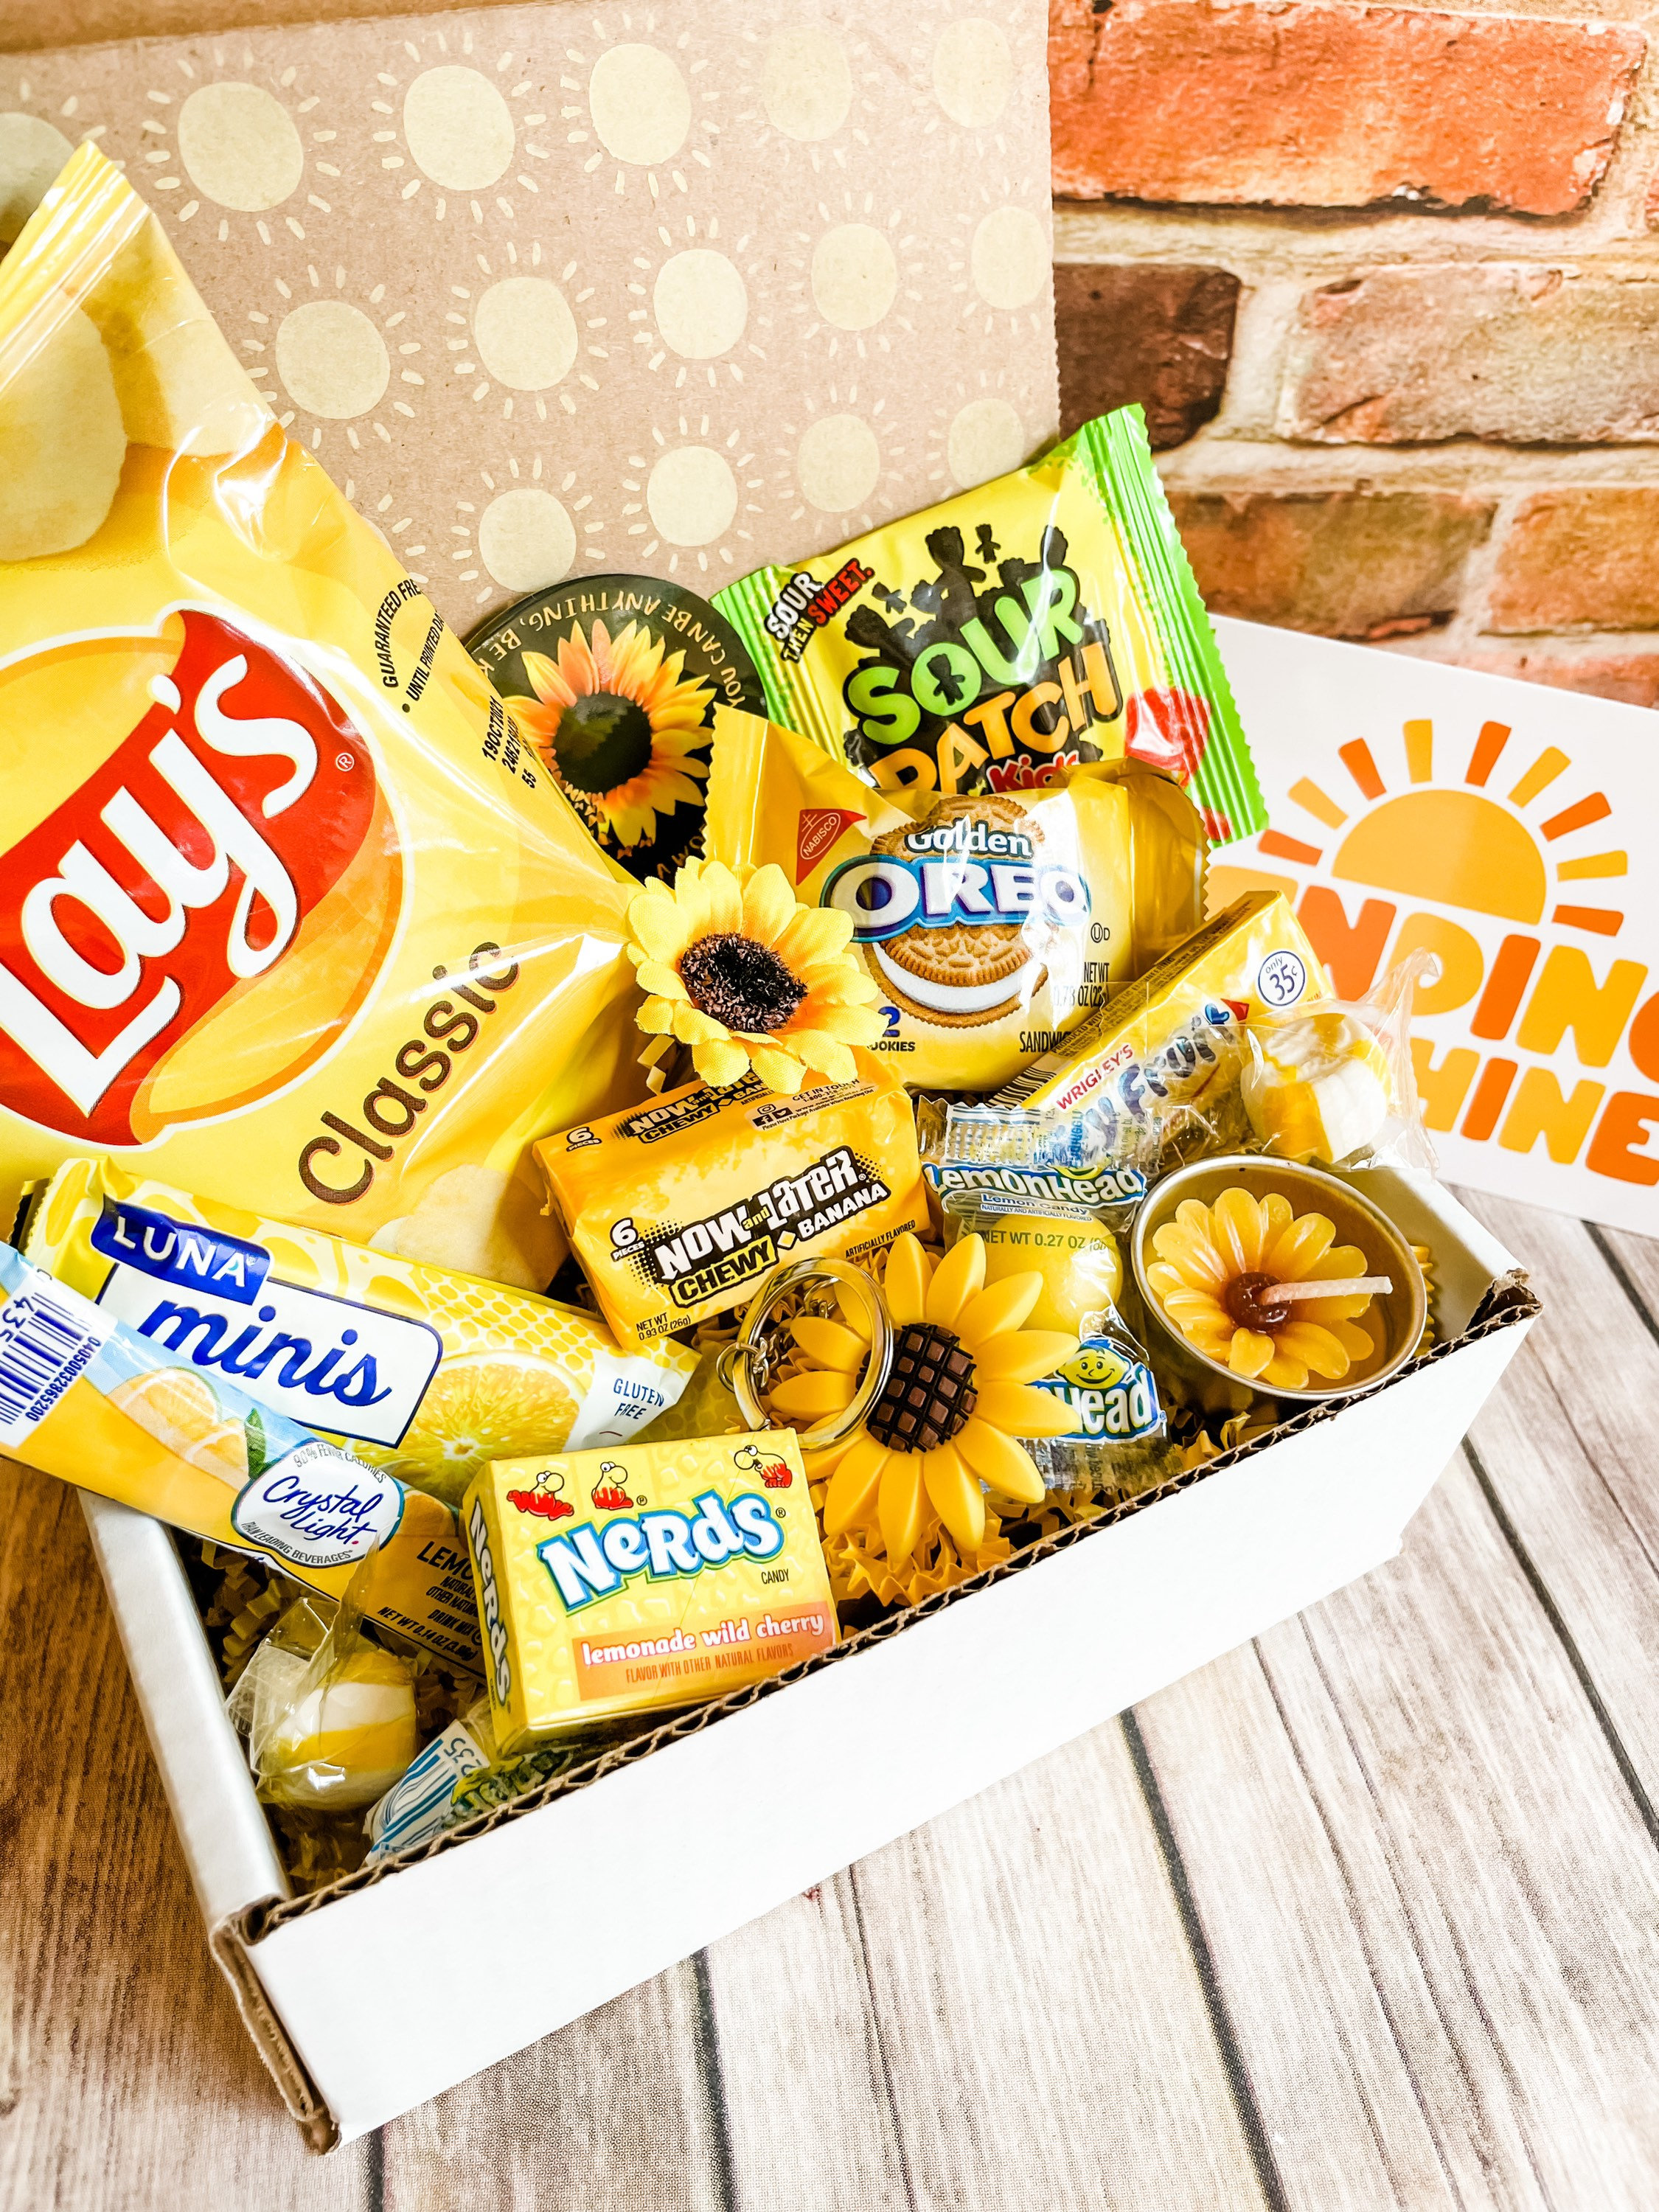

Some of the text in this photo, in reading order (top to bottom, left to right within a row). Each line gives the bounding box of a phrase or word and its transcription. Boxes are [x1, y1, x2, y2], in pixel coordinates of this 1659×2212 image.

[519, 591, 662, 633] ANYTHING,
[662, 603, 692, 625] BE
[766, 573, 824, 640] SOUR
[782, 560, 873, 661] THEN SWEET.
[375, 578, 422, 688] GUARANTEED FRE
[489, 627, 521, 662] BE
[686, 626, 727, 666] CAN
[406, 611, 445, 701] UNTIL PRINTED DA
[847, 569, 1083, 745] SOUR
[721, 667, 746, 708] YOU
[869, 640, 1118, 794] PATCH
[986, 750, 1079, 794] Kid
[802, 815, 838, 857] NABISCO
[906, 818, 1033, 855] Golden
[0, 653, 319, 1119] Lay's
[827, 857, 1088, 920] OREO
[1084, 962, 1109, 983] NET WT
[1209, 866, 1659, 1085] NDIN
[1265, 956, 1283, 974] only
[1077, 985, 1089, 1006] OZ
[878, 1006, 900, 1037] 2
[1051, 1023, 1088, 1054] PRODUCED
[866, 1031, 1073, 1053] OOKIES SANDWI
[298, 941, 521, 1206] Classic
[644, 1105, 716, 1141] CHEWY
[734, 1083, 769, 1099] BAN
[792, 1091, 810, 1102] GET
[812, 1087, 824, 1096] IN
[1409, 1038, 1659, 1187] HINE
[568, 1127, 593, 1141] 6
[628, 1096, 699, 1135] NOW
[981, 1204, 1014, 1214] NATURALLY
[982, 1193, 1037, 1208] Lemon
[112, 1216, 248, 1289] LUNA
[610, 1218, 639, 1249] 6
[653, 1203, 750, 1280] NOW
[740, 1204, 771, 1232] and
[611, 1183, 888, 1301] PIECES CHEWY BANANA
[844, 1219, 917, 1259] ARTIFICIALLY FLAVORED
[983, 1231, 1007, 1244] NET
[1009, 1232, 1032, 1245] WT
[1034, 1234, 1064, 1247] 0.27
[1068, 1236, 1085, 1249] OZ
[636, 1312, 669, 1332] NET WT
[638, 1315, 692, 1342] 0.93 OZ (26g)
[137, 1301, 393, 1408] minis
[613, 1377, 664, 1407] GLUTEN
[614, 1402, 647, 1419] FREE
[1034, 1367, 1153, 1436] Head
[344, 1452, 387, 1484] CALORIES
[262, 1475, 384, 1523] Crystal
[241, 1520, 259, 1538] THAN
[254, 1530, 293, 1555] LEADING
[417, 1540, 476, 1581] LEMO
[760, 1568, 790, 1586] CANDY
[425, 1586, 479, 1618] OTHER NATURA
[427, 1608, 460, 1630] DRINK
[377, 1606, 403, 1621] NET
[397, 1616, 419, 1630] WT
[413, 1625, 437, 1641] 0.14
[581, 1613, 825, 1666] lemonade wild cherry
[625, 1643, 794, 1683] FLAVOR WITH OTHER NATURAL FLAVORS
